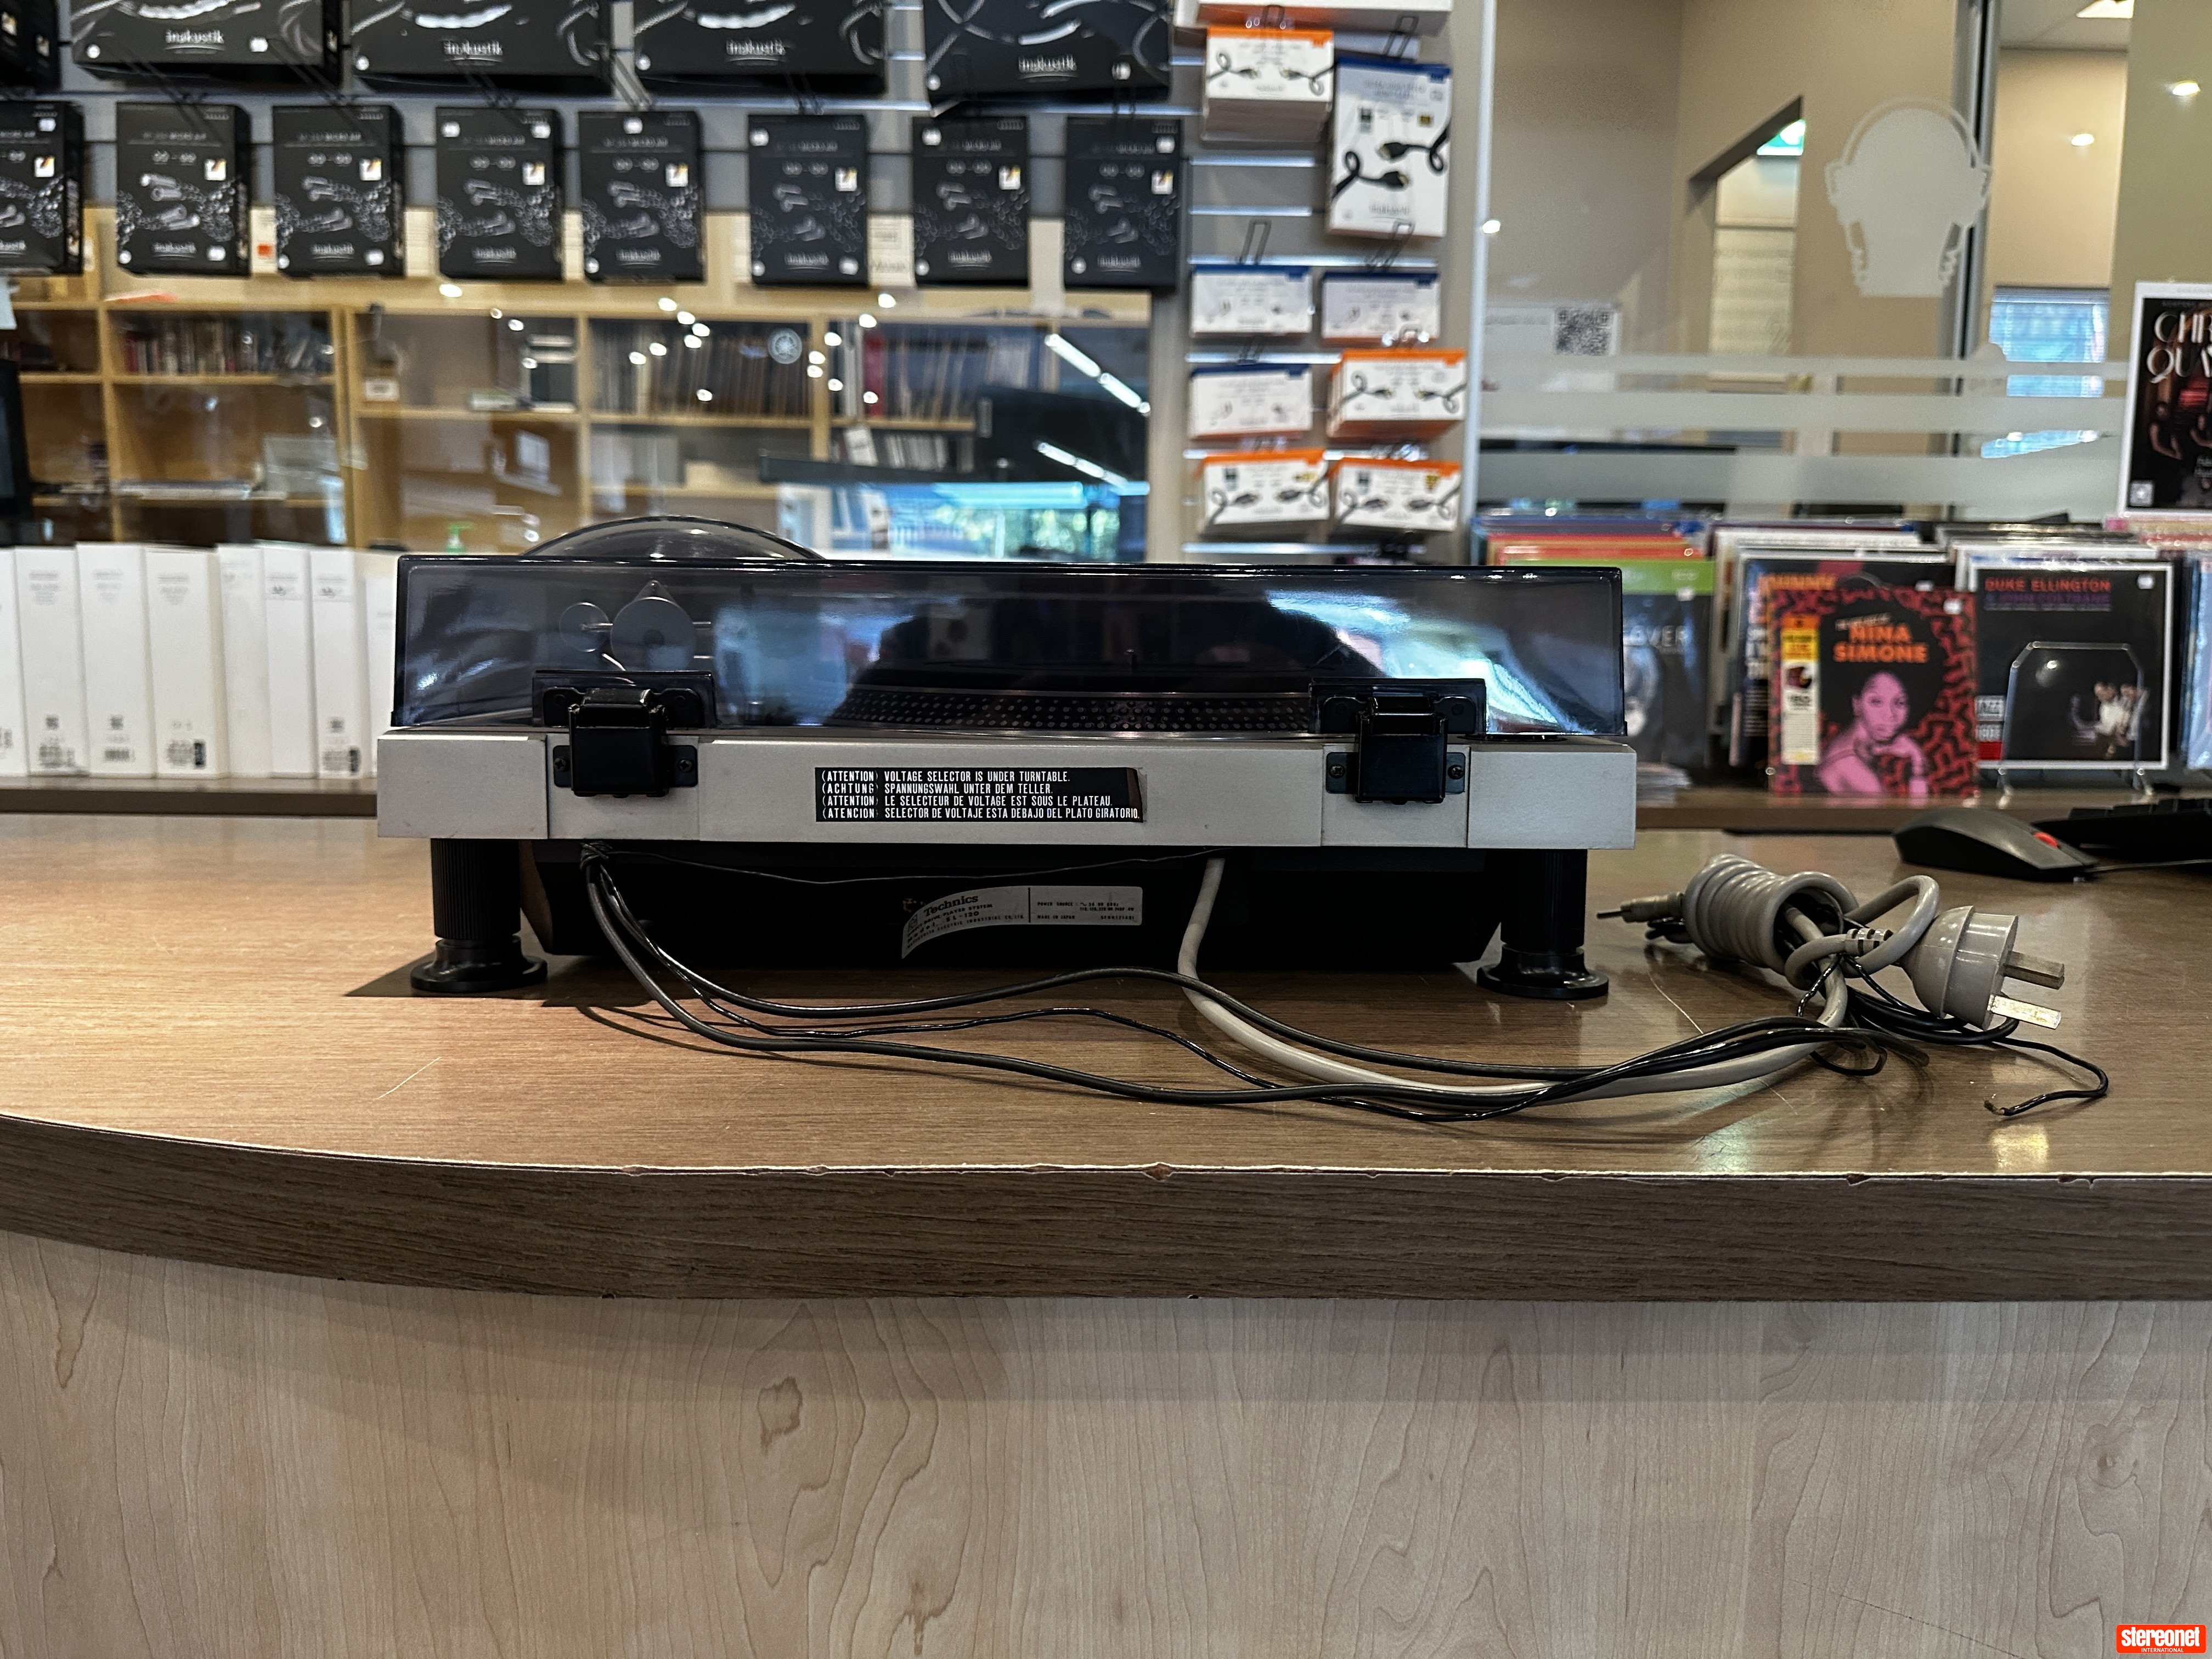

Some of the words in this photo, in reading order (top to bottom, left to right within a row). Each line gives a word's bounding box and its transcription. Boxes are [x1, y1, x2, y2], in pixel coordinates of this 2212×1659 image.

[1848, 622, 1911, 642] NINA
[1833, 641, 1928, 663] SIMONE
[884, 771, 923, 782] VOLTAGE
[927, 771, 971, 782] SELECTOR
[975, 771, 983, 782] IS
[987, 771, 1015, 782] UNDER
[1019, 771, 1070, 782] TURNTABLE.
[884, 783, 960, 794] SPANNUNGSWAHL
[963, 783, 991, 794] UNTER
[995, 783, 1013, 794] DEM
[1017, 783, 1053, 794] TELLER.
[884, 795, 896, 806] LE
[900, 795, 949, 806] SELECTEUR
[953, 795, 964, 806] DE
[968, 795, 1006, 806] VOLTAGE
[1011, 795, 1028, 806] EST
[1031, 795, 1053, 806] SOUS
[1057, 795, 1068, 806] LE
[1072, 795, 1113, 806] PLATEAU.
[884, 807, 929, 819] SELECTOR
[932, 808, 943, 819] DE
[945, 808, 983, 819] VOLTAJE
[986, 808, 1008, 819] ESTA
[1011, 808, 1044, 819] DEBAJO
[1047, 808, 1063, 819] DEL
[1065, 808, 1093, 819] PLATO
[1095, 808, 1140, 819] GIRATORIO.
[924, 895, 979, 917] Technics
